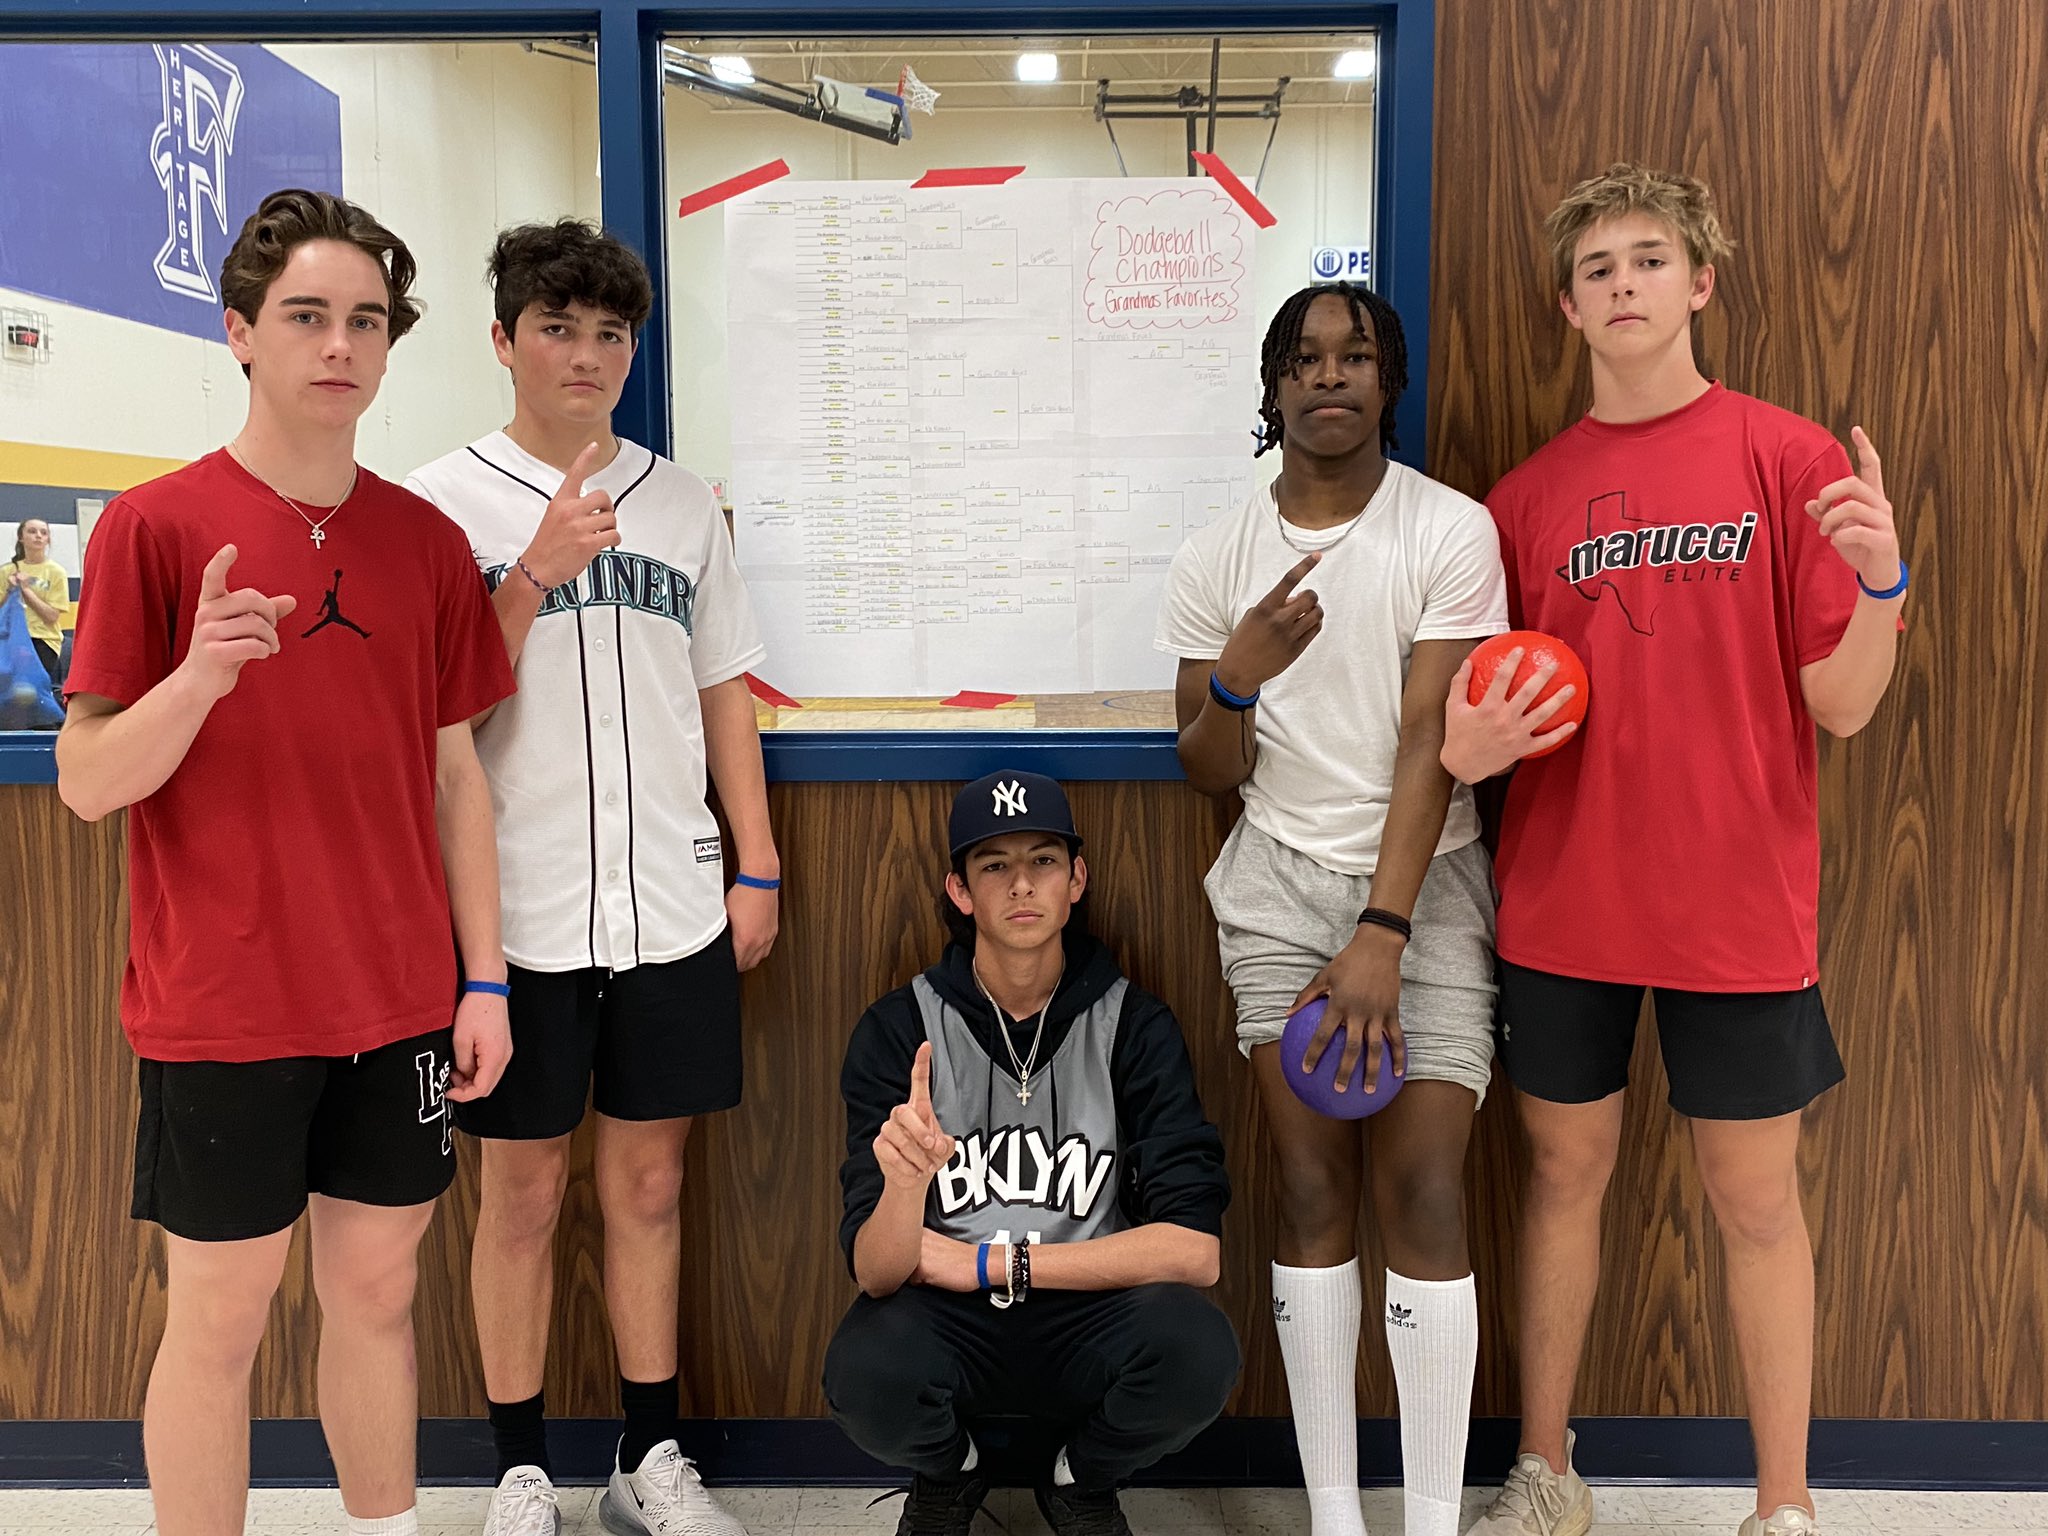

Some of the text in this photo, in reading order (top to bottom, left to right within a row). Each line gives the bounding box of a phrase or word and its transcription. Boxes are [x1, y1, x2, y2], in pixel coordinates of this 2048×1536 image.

[170, 48, 189, 268] HERITAGE
[1116, 219, 1211, 267] Dodgeball
[1116, 252, 1224, 287] Champions
[1105, 285, 1227, 313] Grandmas Favorites
[1568, 511, 1759, 585] marucci
[1663, 566, 1743, 583] ELITE
[991, 779, 1028, 816] NY
[935, 1126, 1114, 1219] BKLYN
